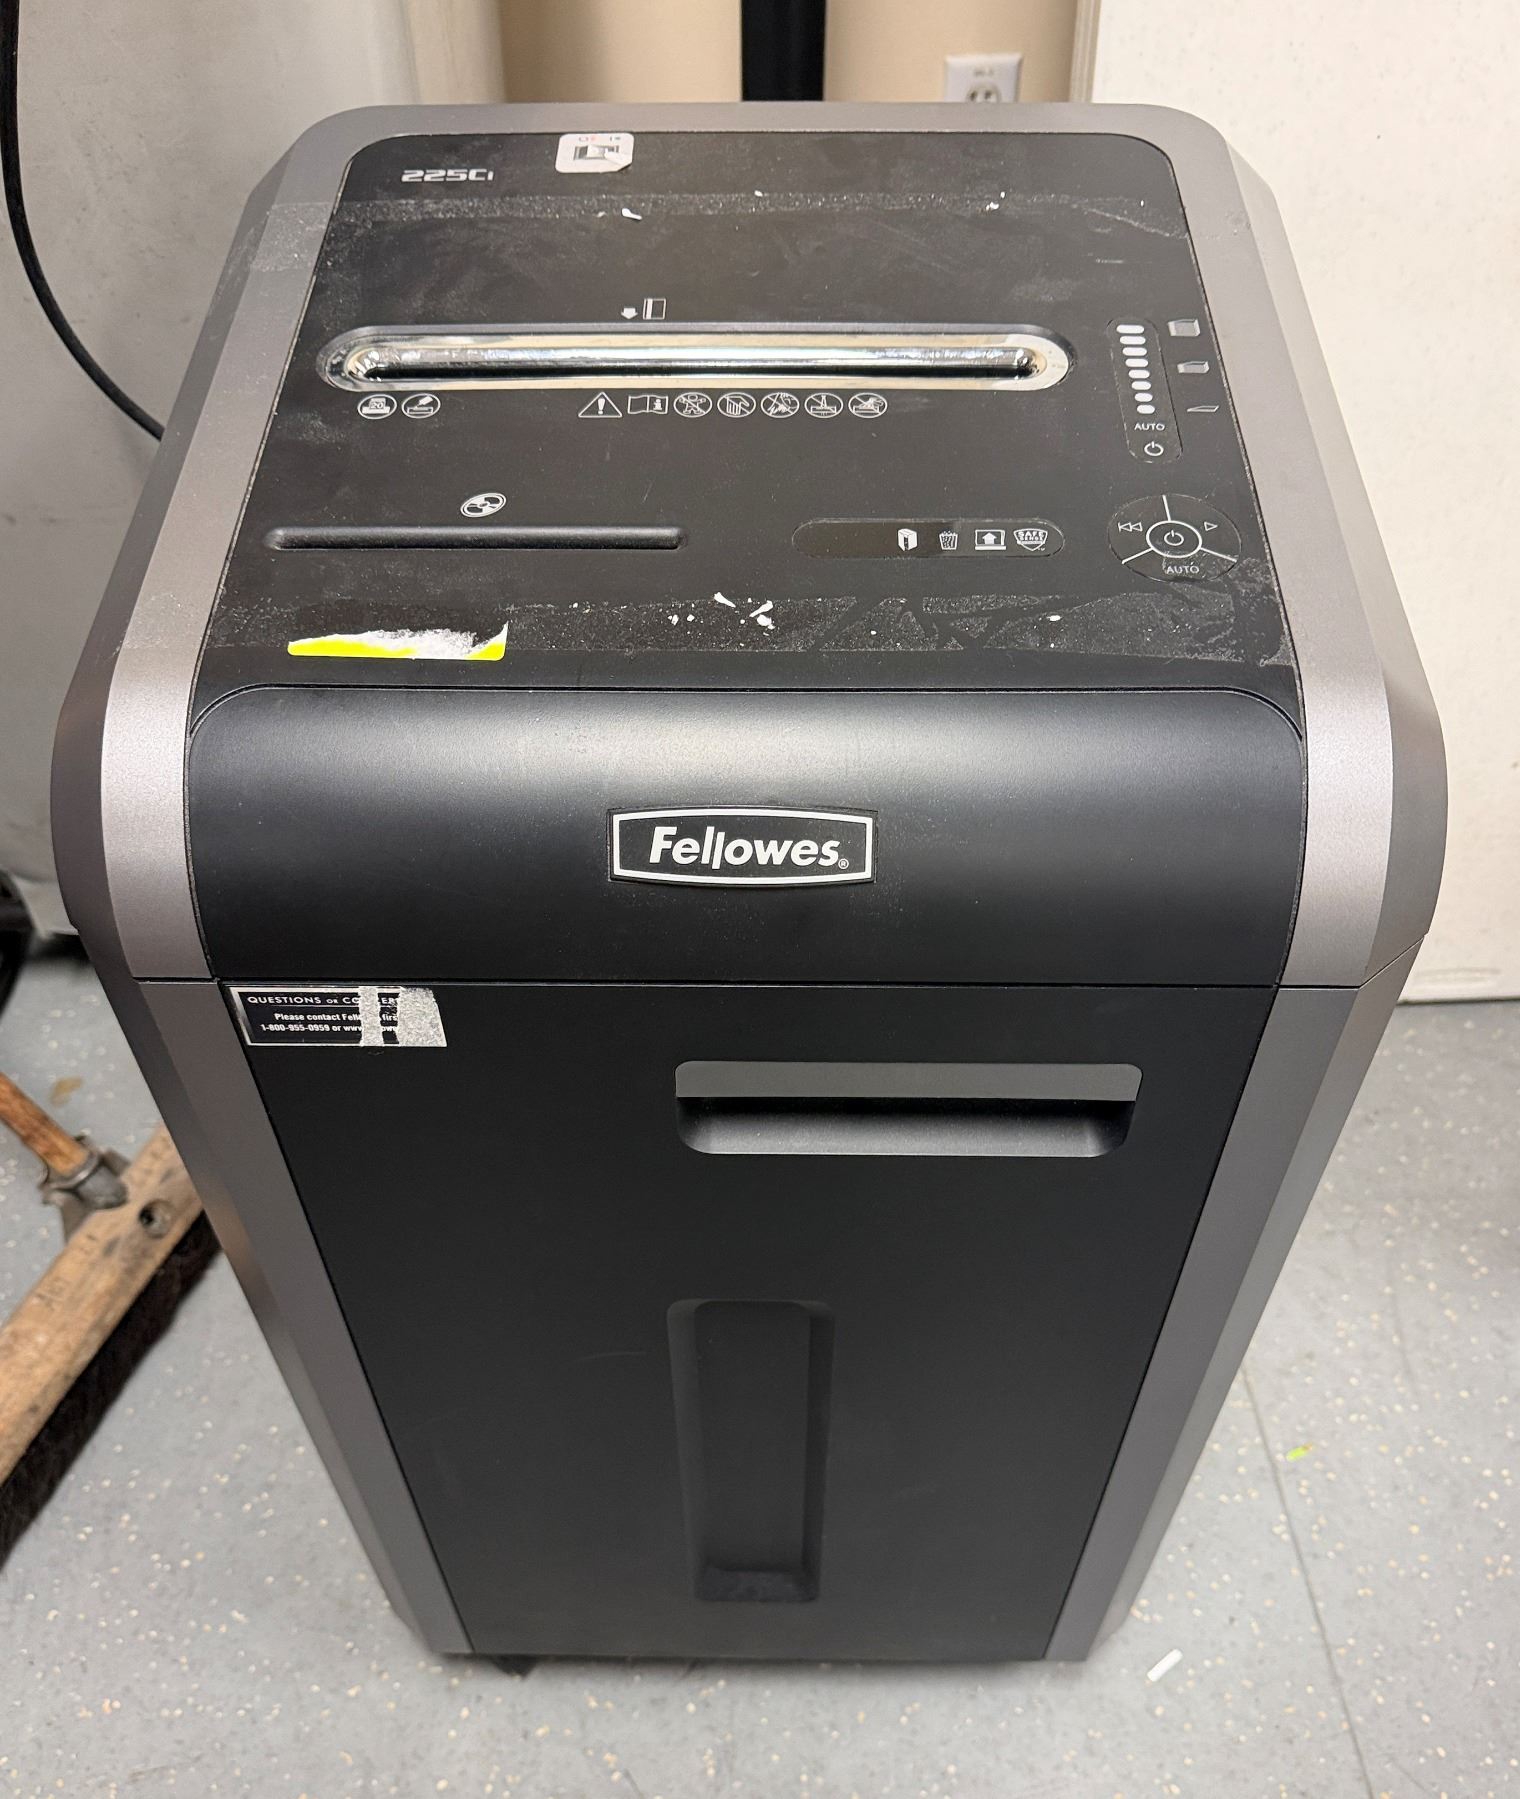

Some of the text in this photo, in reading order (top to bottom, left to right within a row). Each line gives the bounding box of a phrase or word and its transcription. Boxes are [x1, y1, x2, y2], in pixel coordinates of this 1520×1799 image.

[1134, 422, 1165, 431] AUTO
[1166, 565, 1200, 574] AUTO
[649, 826, 840, 870] Fellowes
[247, 996, 321, 1004] QUESTIONS
[274, 1013, 305, 1021] Please
[306, 1013, 341, 1021] contact
[260, 1024, 330, 1032] 1-800-955-0959
